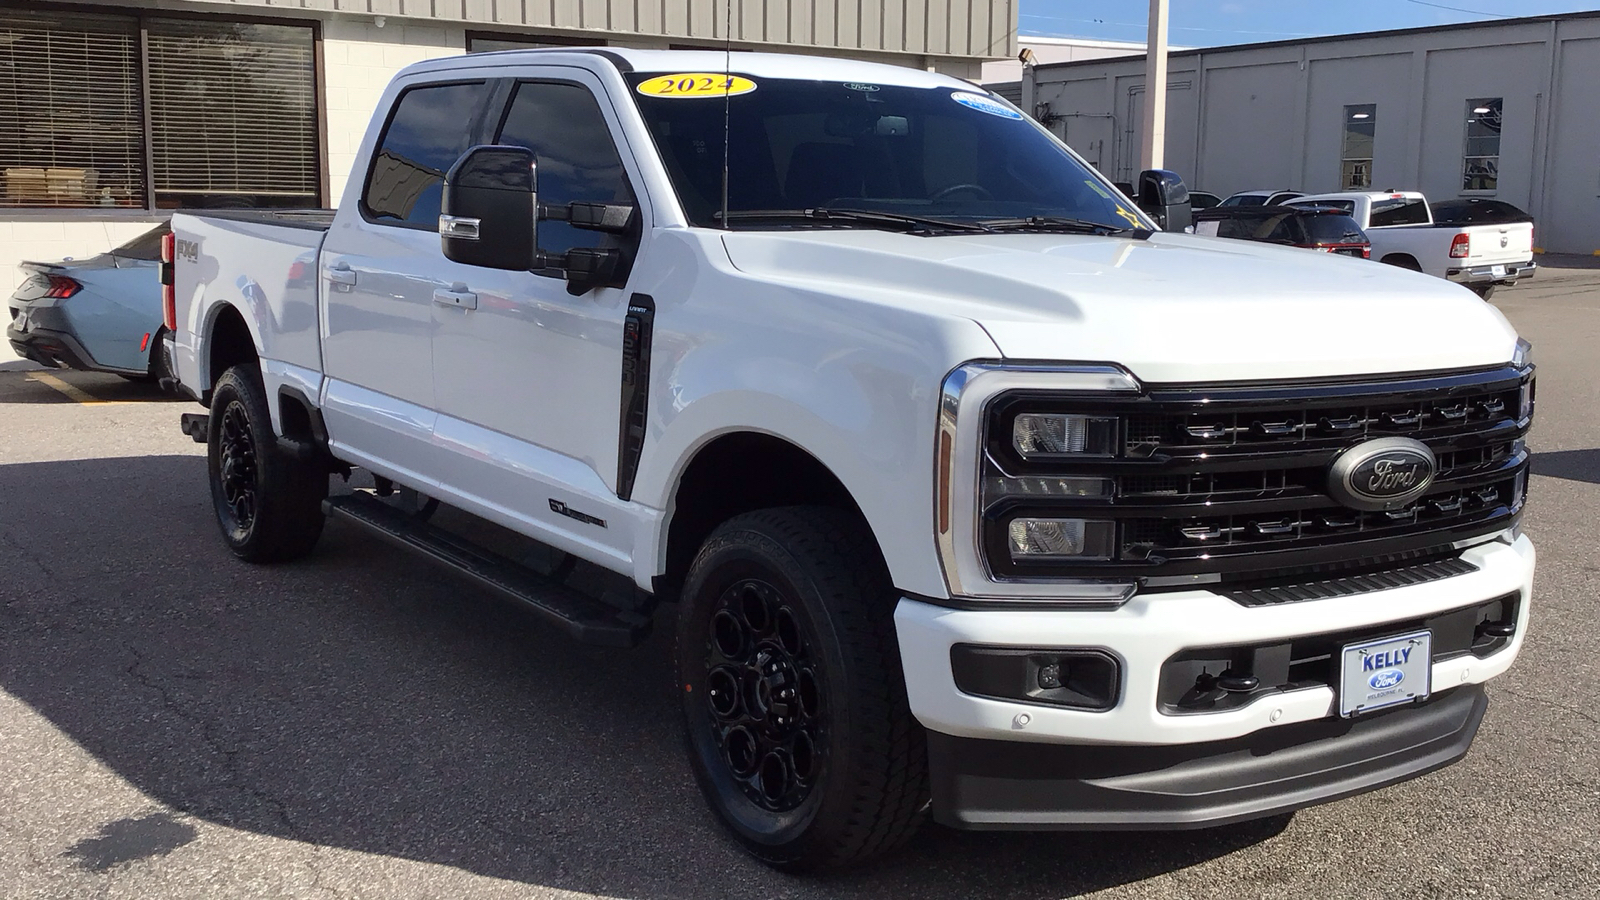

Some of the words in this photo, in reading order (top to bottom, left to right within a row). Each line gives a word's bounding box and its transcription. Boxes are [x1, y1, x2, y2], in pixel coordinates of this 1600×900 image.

[658, 78, 735, 94] 2024
[177, 239, 198, 260] FX4
[1368, 459, 1418, 491] Ford
[1362, 646, 1412, 672] KELLY
[1375, 672, 1399, 688] Ford
